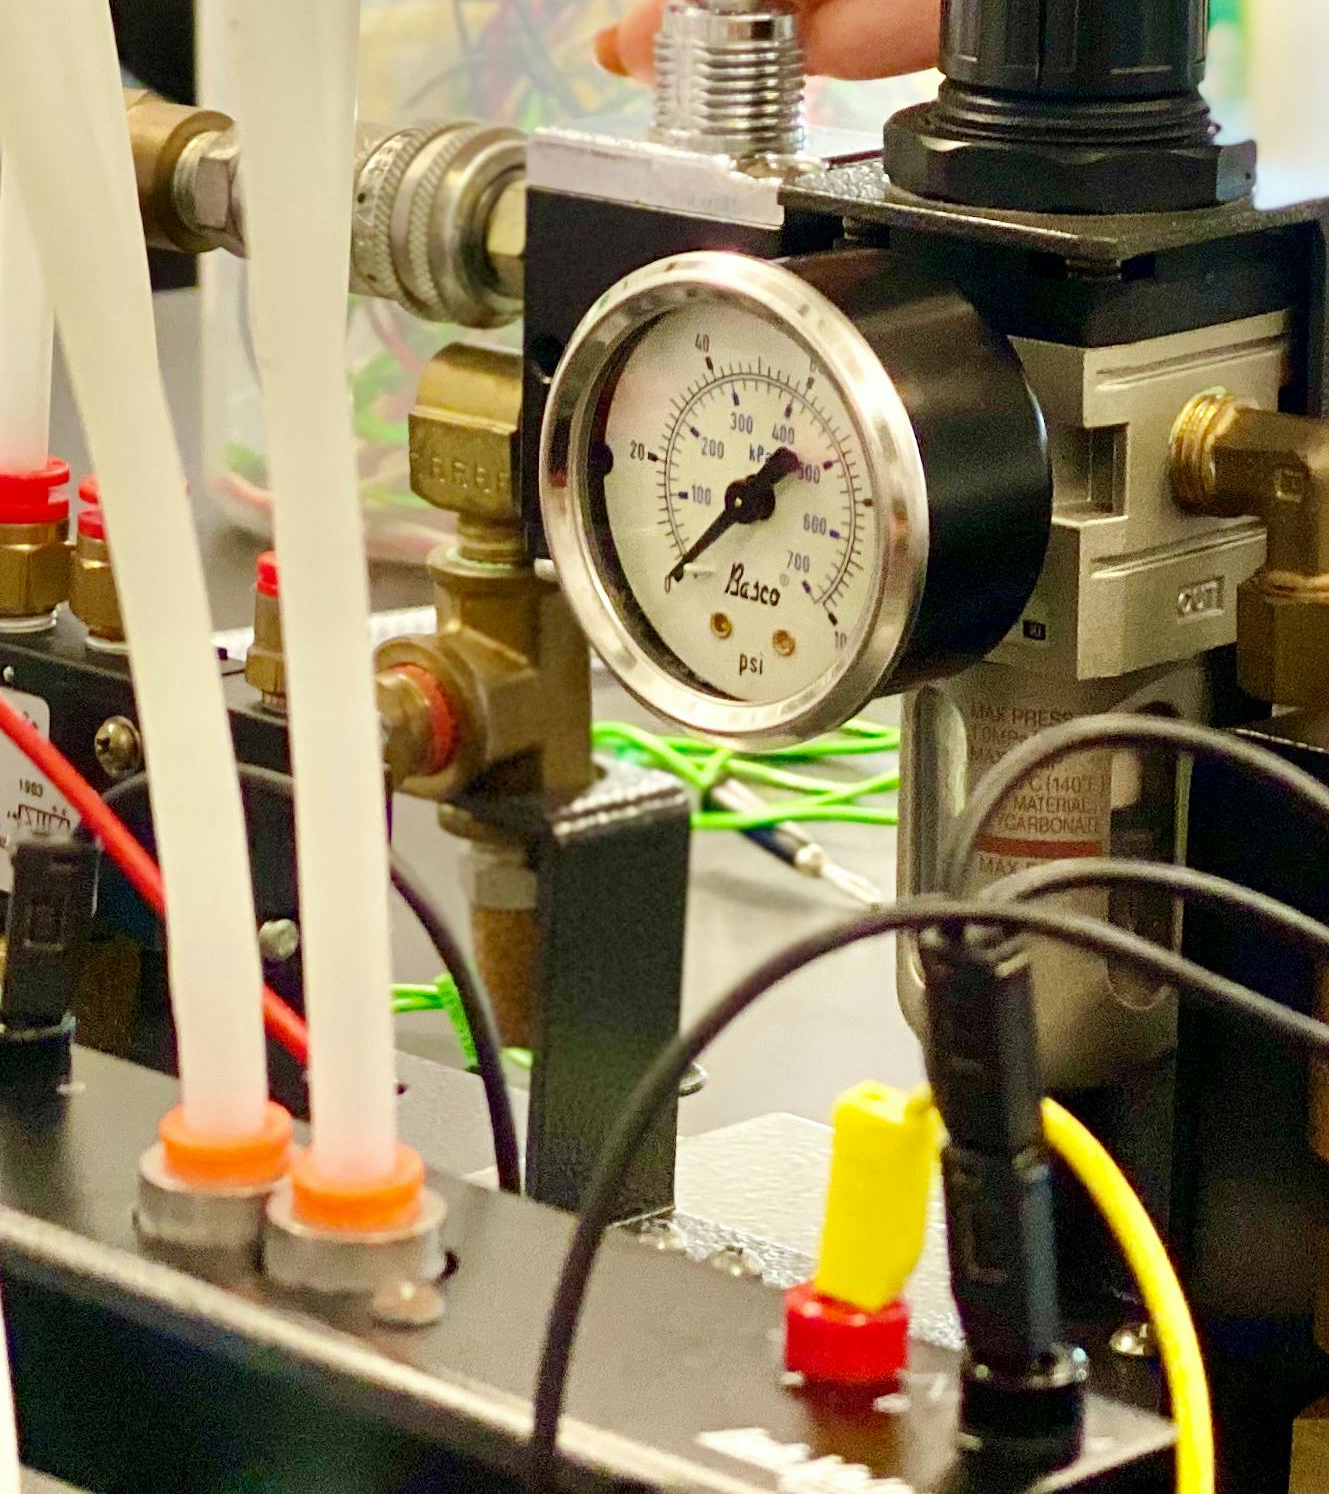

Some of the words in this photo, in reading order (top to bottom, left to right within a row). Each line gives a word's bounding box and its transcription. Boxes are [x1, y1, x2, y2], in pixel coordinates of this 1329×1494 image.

[695, 333, 710, 353] 40
[730, 412, 753, 435] 300
[772, 424, 795, 445] 400
[630, 439, 645, 461] 20
[701, 437, 725, 460] 200
[691, 482, 711, 506] 100
[803, 513, 827, 536] 600
[787, 550, 811, 573] 700
[739, 651, 764, 676] psi
